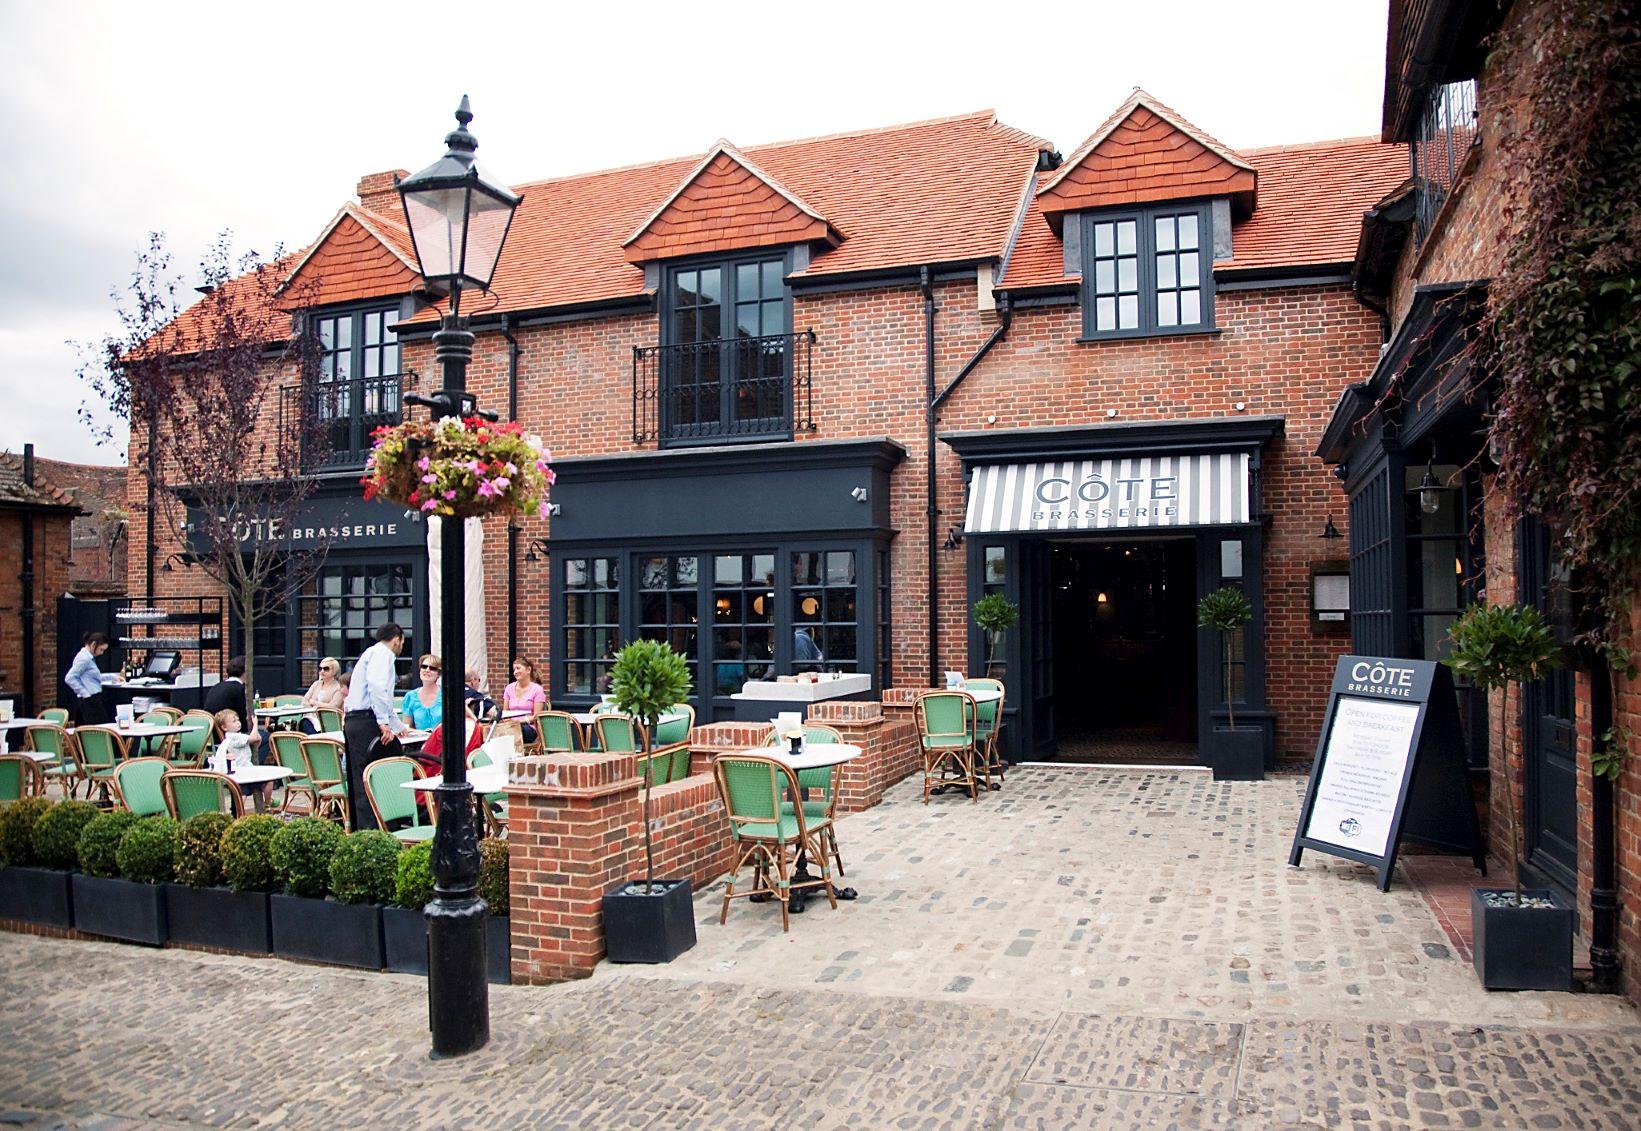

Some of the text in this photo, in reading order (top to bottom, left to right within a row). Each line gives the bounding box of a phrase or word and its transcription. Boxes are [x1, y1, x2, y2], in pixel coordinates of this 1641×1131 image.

[1035, 472, 1177, 504] CÔTE
[1032, 506, 1177, 520] BRASSERIE
[209, 512, 397, 541] ÔTE BRASSERIE
[1352, 661, 1415, 687] CÔTE
[1348, 683, 1410, 697] BRASSERIE
